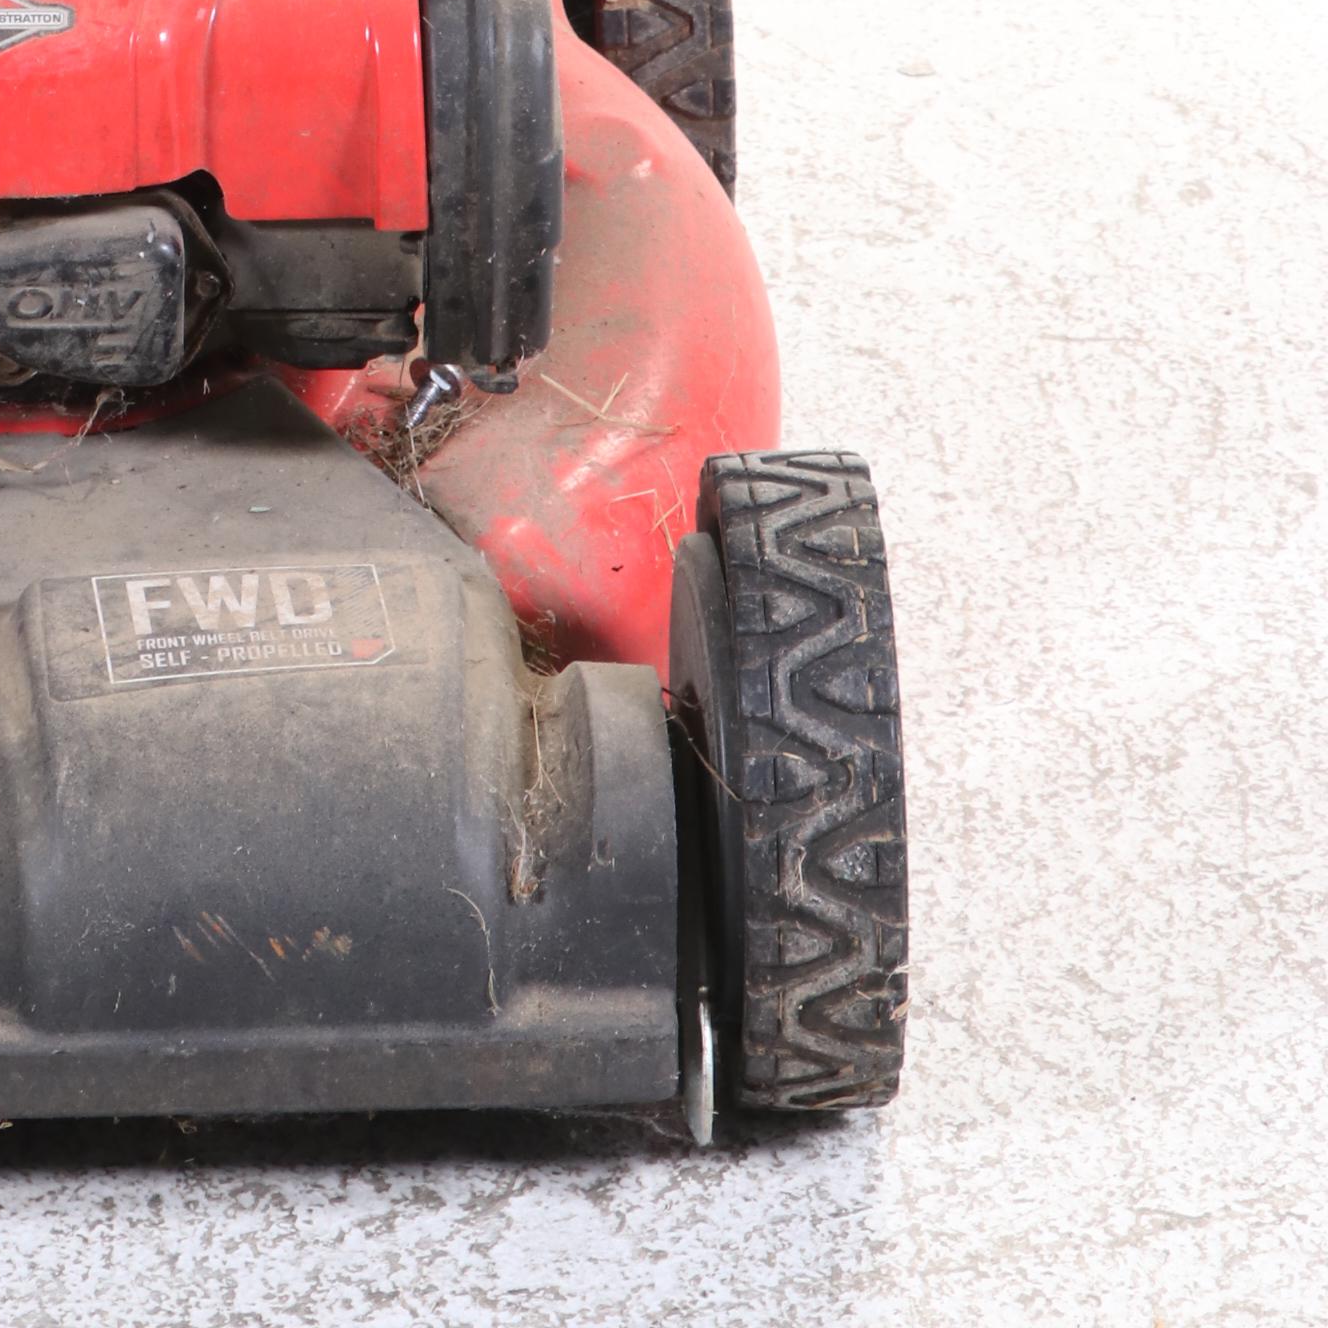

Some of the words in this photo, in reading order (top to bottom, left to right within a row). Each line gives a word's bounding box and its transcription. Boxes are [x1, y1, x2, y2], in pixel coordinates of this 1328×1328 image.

[124, 571, 334, 636] FWD
[135, 636, 188, 652] FRONT
[191, 632, 247, 647] WHEEL
[249, 629, 287, 643] BELT
[291, 626, 339, 641] DRIVE
[139, 652, 193, 669] SELF
[216, 640, 344, 663] PROPELLED
